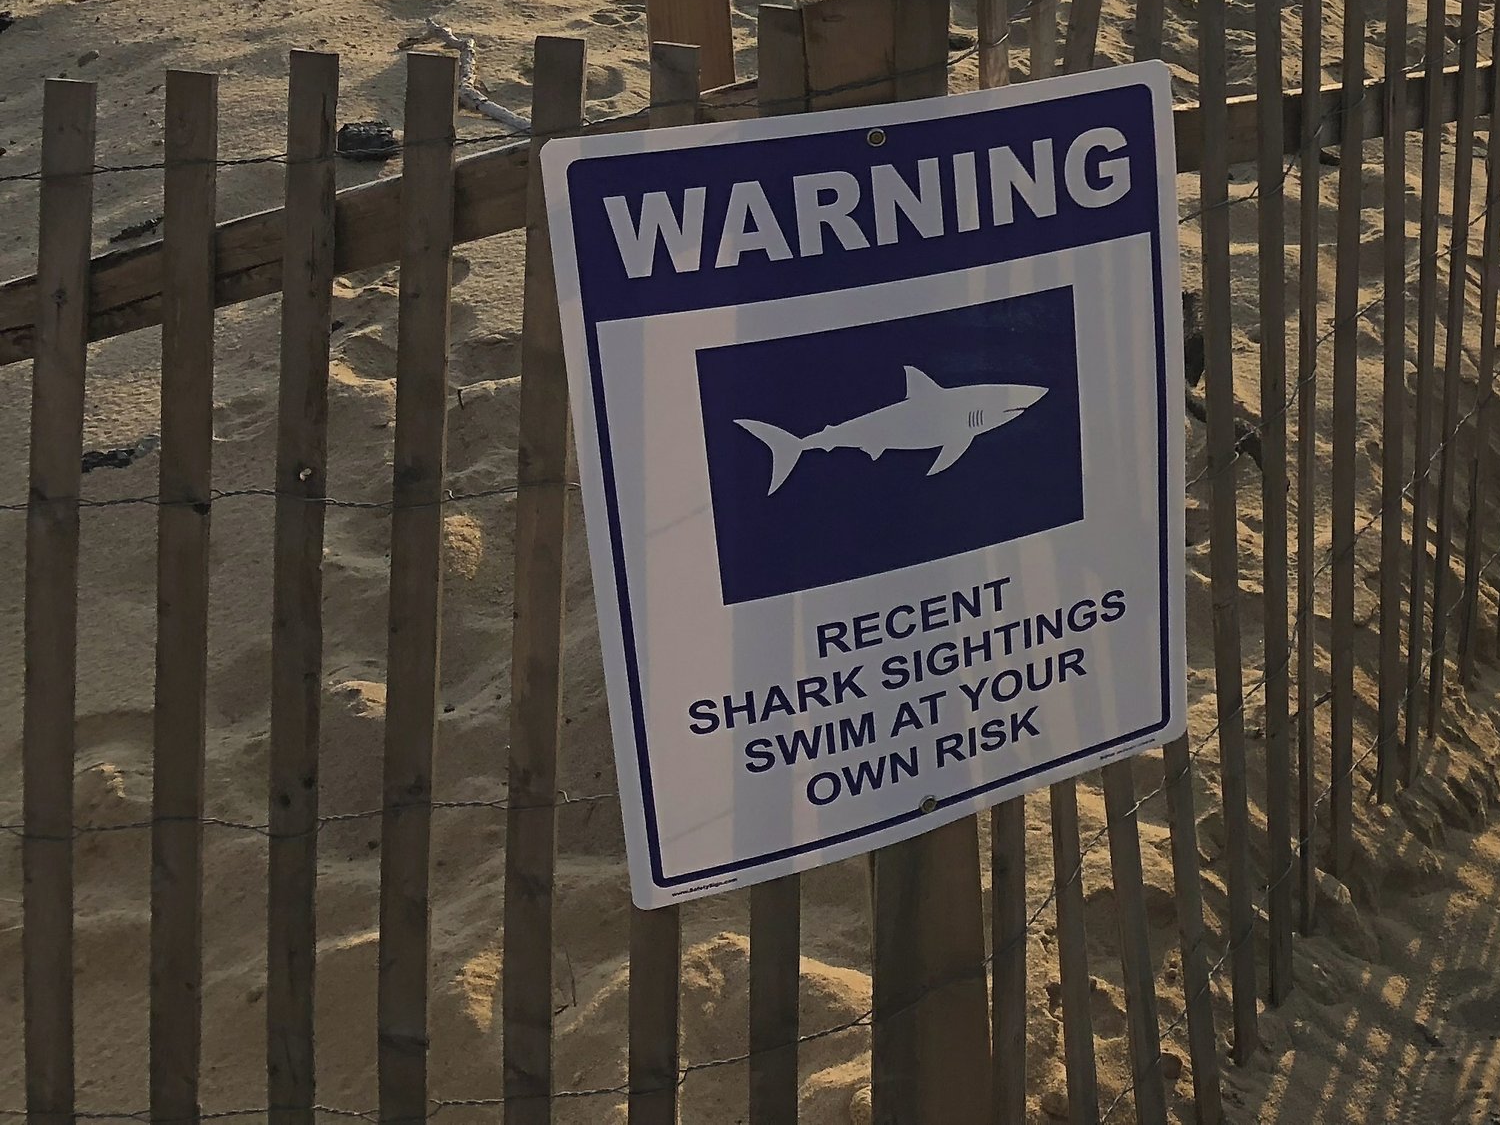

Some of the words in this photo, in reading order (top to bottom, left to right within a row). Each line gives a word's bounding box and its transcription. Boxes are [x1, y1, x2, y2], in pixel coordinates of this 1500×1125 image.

[602, 126, 1132, 279] WARNING
[688, 664, 868, 735] SHARK
[881, 589, 1126, 690] SIGHTINGS
[816, 576, 1011, 659] RECENT
[744, 711, 877, 773] SWIM
[889, 690, 947, 738] AT
[958, 647, 1087, 712] YOUR
[806, 745, 919, 806] OWN
[935, 705, 1041, 769] RISK
